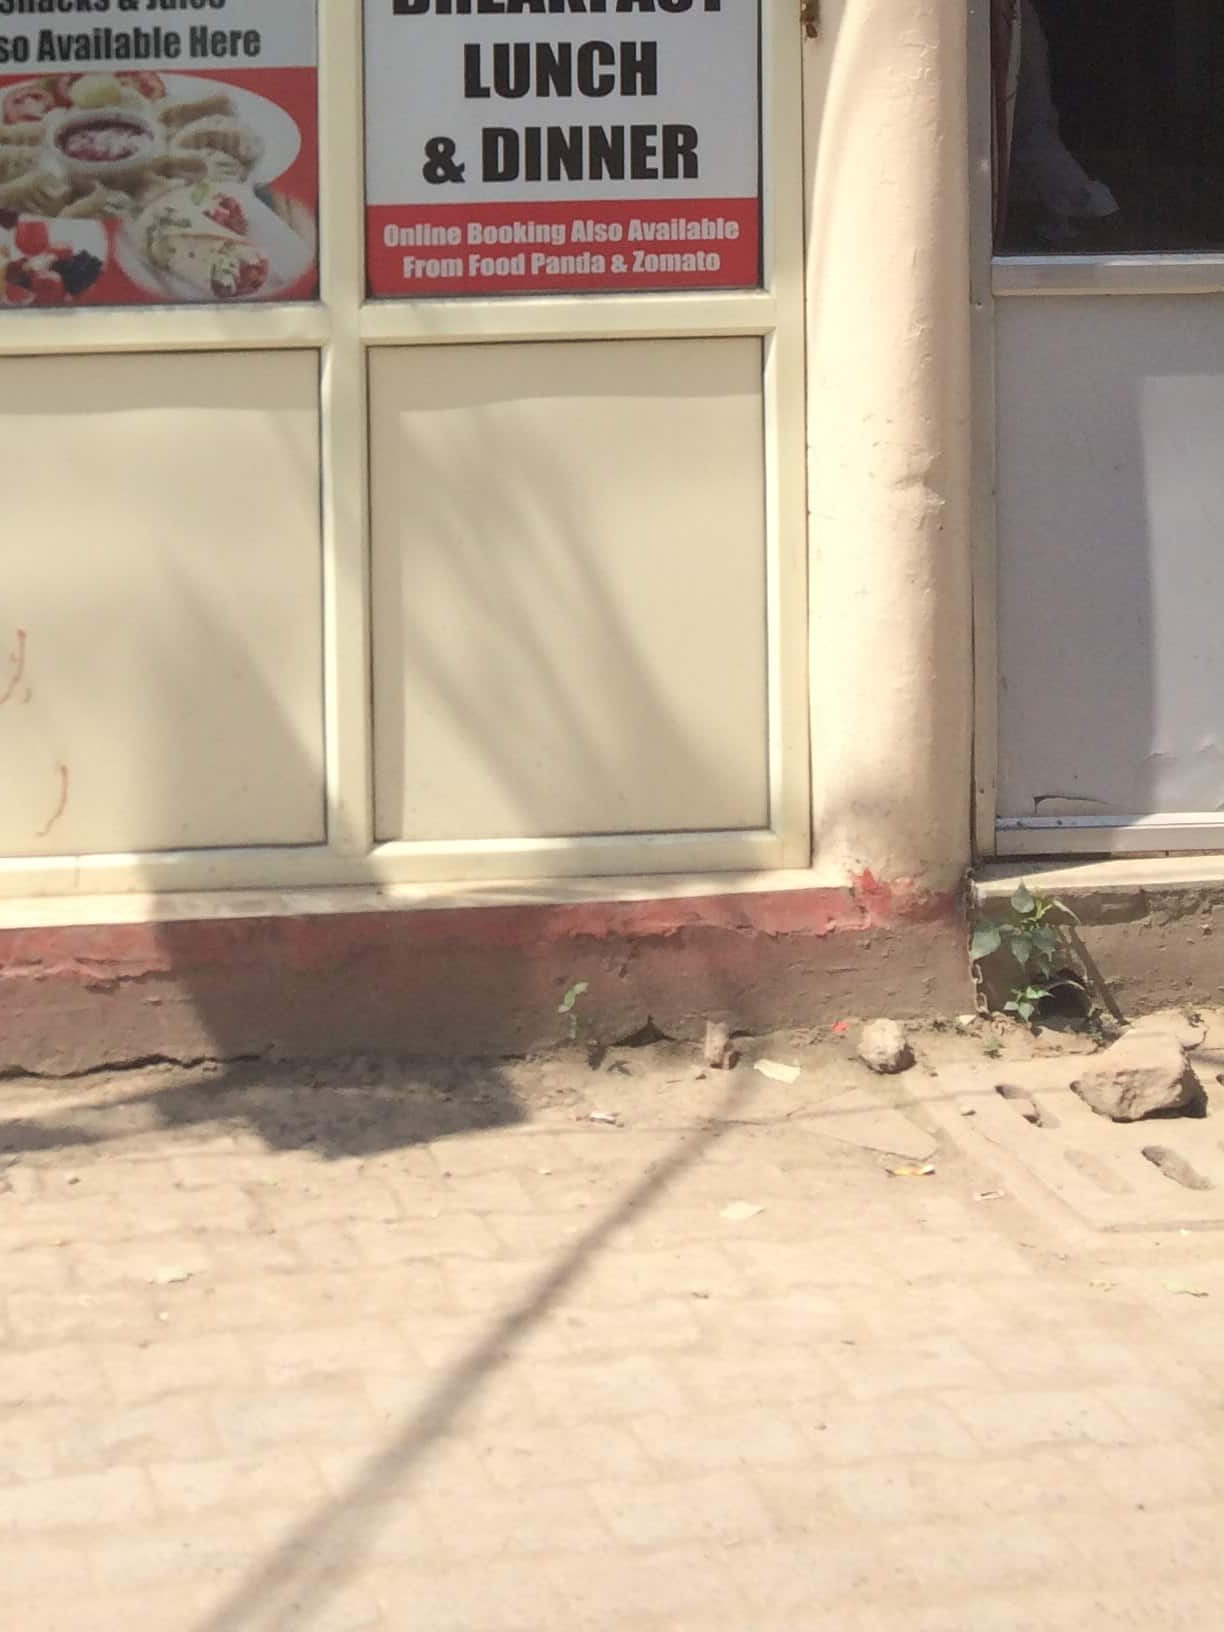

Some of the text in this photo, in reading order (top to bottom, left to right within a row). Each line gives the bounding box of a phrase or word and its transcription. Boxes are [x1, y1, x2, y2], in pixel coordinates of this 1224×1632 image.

[37, 27, 181, 63] Available
[188, 25, 261, 58] Here
[464, 41, 658, 98] LUNCH
[422, 124, 698, 184] & DINNER
[383, 218, 740, 247] Online Booking Also Available
[403, 251, 720, 278] From Food Panda & Zomato
